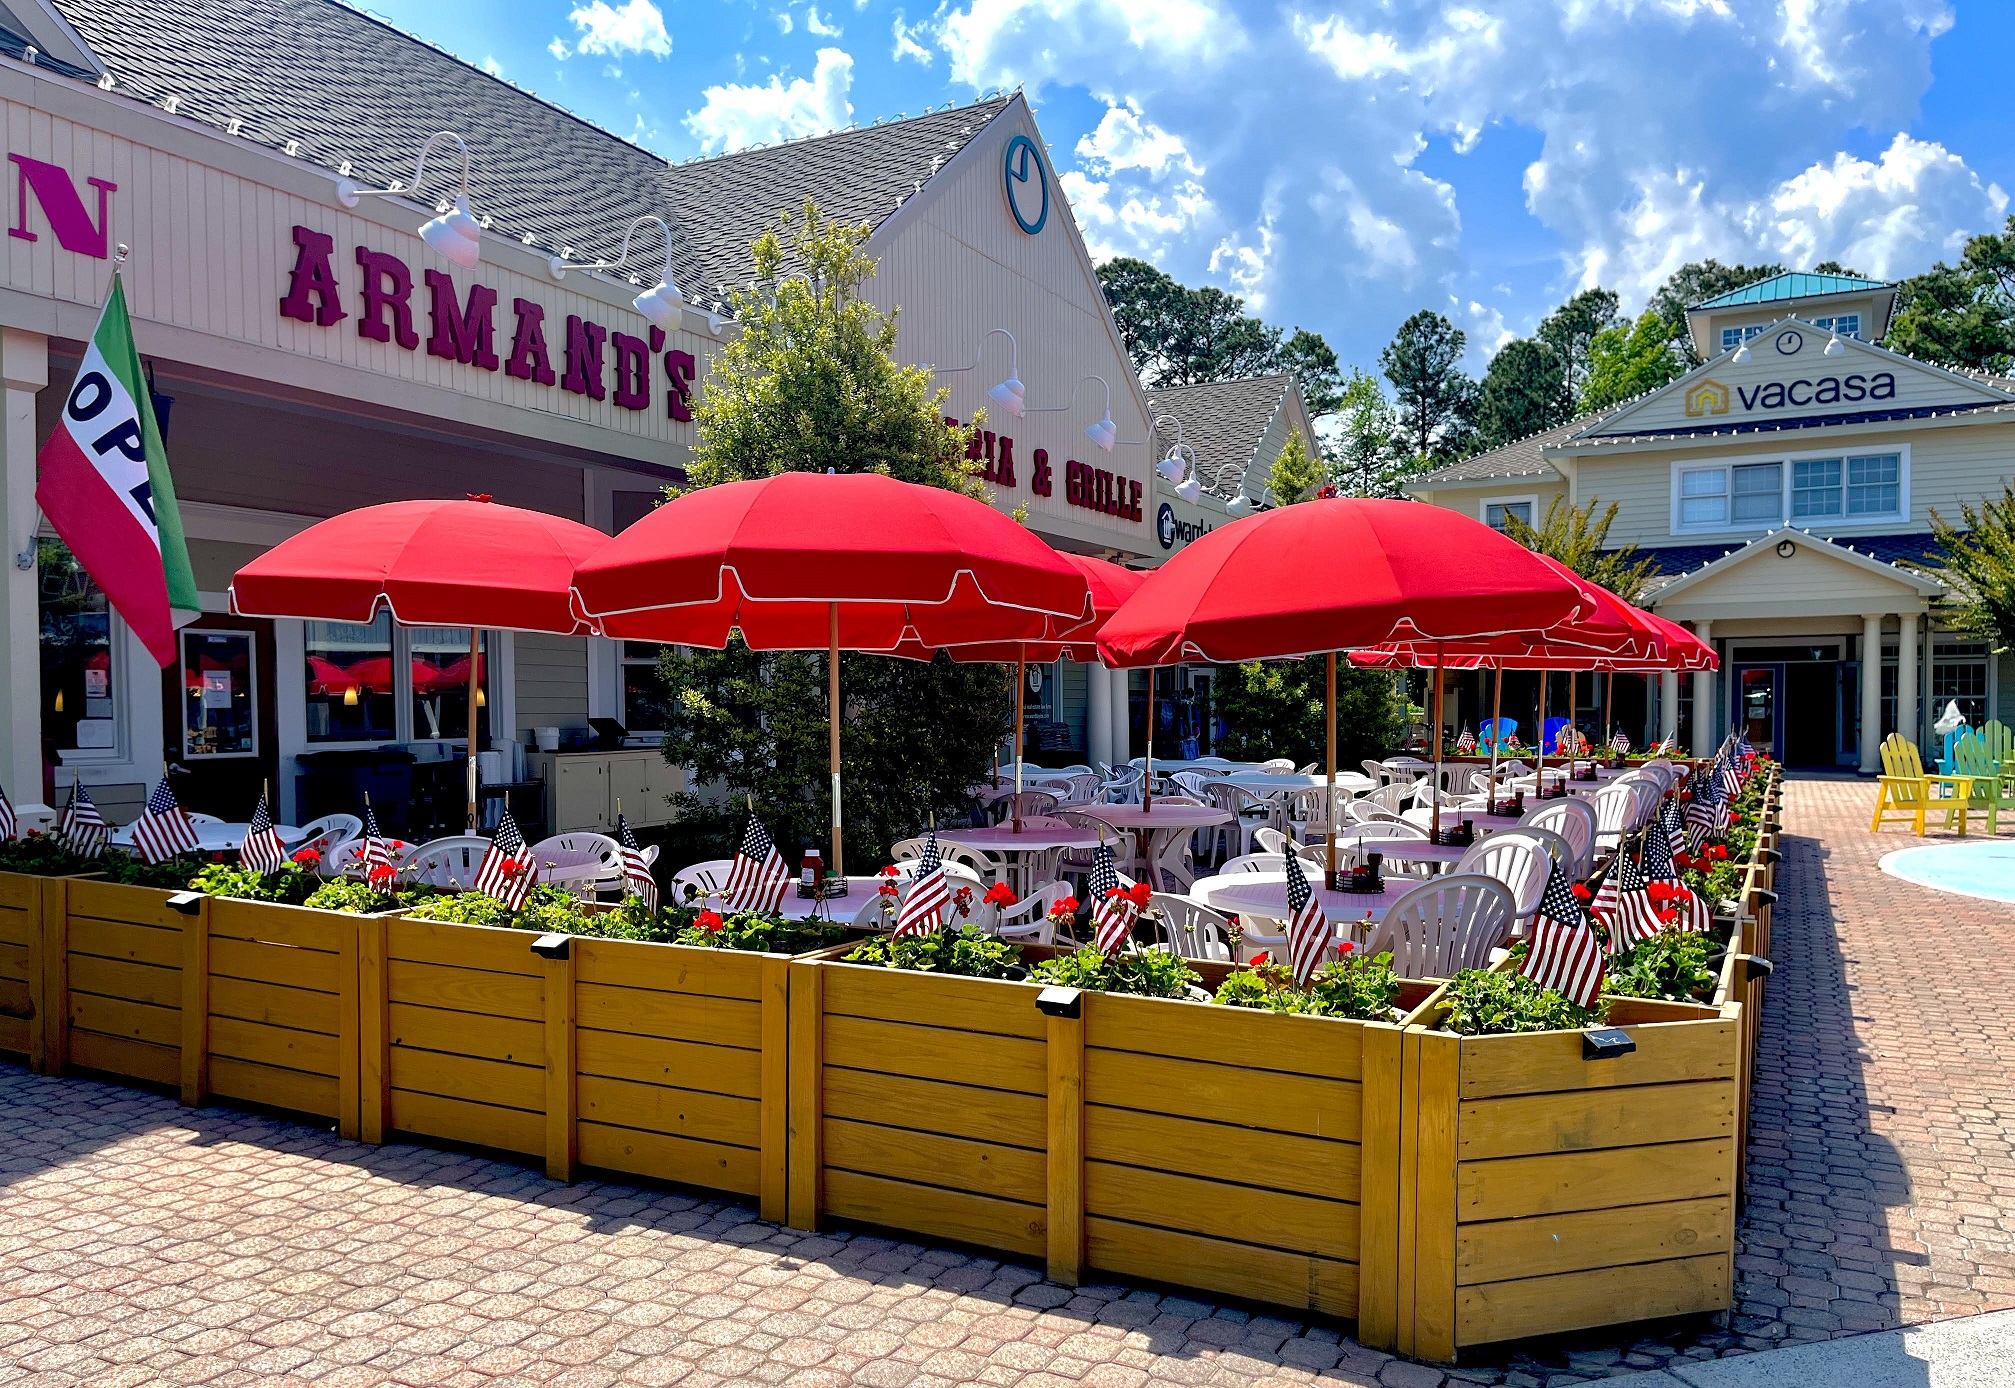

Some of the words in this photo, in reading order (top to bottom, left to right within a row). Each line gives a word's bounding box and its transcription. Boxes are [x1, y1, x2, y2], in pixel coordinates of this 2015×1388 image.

[8, 152, 117, 259] N
[280, 225, 695, 422] ARMAND'S
[1737, 373, 1895, 411] vacasa
[1032, 449, 1052, 497] &
[1065, 460, 1143, 522] GRILLE
